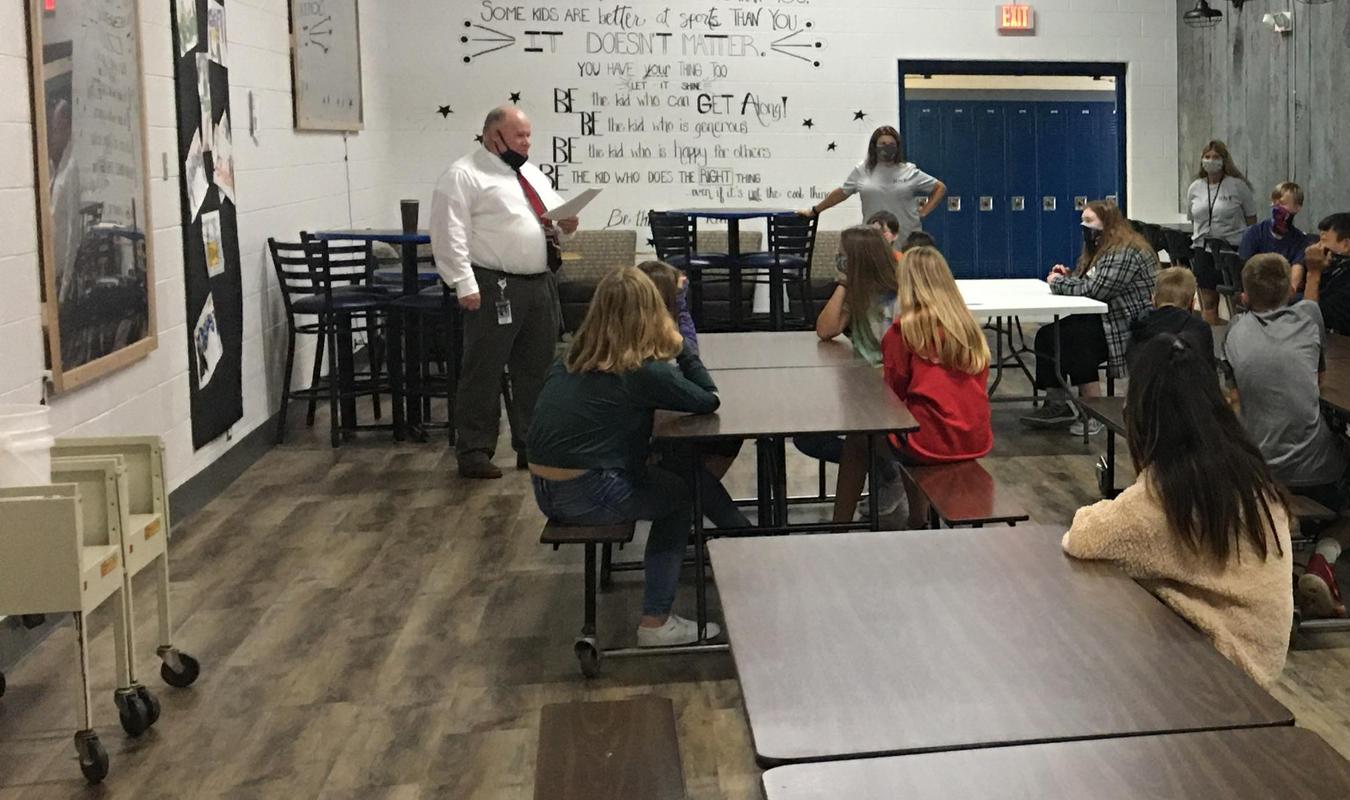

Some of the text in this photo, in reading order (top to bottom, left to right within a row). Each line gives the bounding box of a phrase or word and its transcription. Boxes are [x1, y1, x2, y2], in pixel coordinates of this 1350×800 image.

[481, 0, 797, 31] SOME KIDS ARE better at sports THAN YOU
[1002, 6, 1029, 27] EXIT
[524, 31, 563, 53] IT
[587, 31, 672, 55] DOESN'T
[577, 61, 728, 79] YOU HAVE your THING TOO
[631, 81, 647, 90] LET
[661, 81, 669, 89] IT
[554, 87, 582, 113] BE
[592, 92, 608, 106] the
[616, 92, 631, 106] kid
[637, 91, 660, 107] who
[667, 95, 690, 107] can
[697, 93, 734, 115] GET
[581, 111, 748, 138] BE the kid who is generous
[553, 136, 771, 166] BE the kid who is happy for others
[571, 170, 591, 183] THE
[595, 170, 610, 183] KID
[615, 171, 640, 183] WHO
[648, 170, 673, 183] DOES
[680, 171, 695, 183] THE
[700, 168, 731, 184] RIGHT
[736, 173, 762, 184] THING
[766, 186, 778, 199] the
